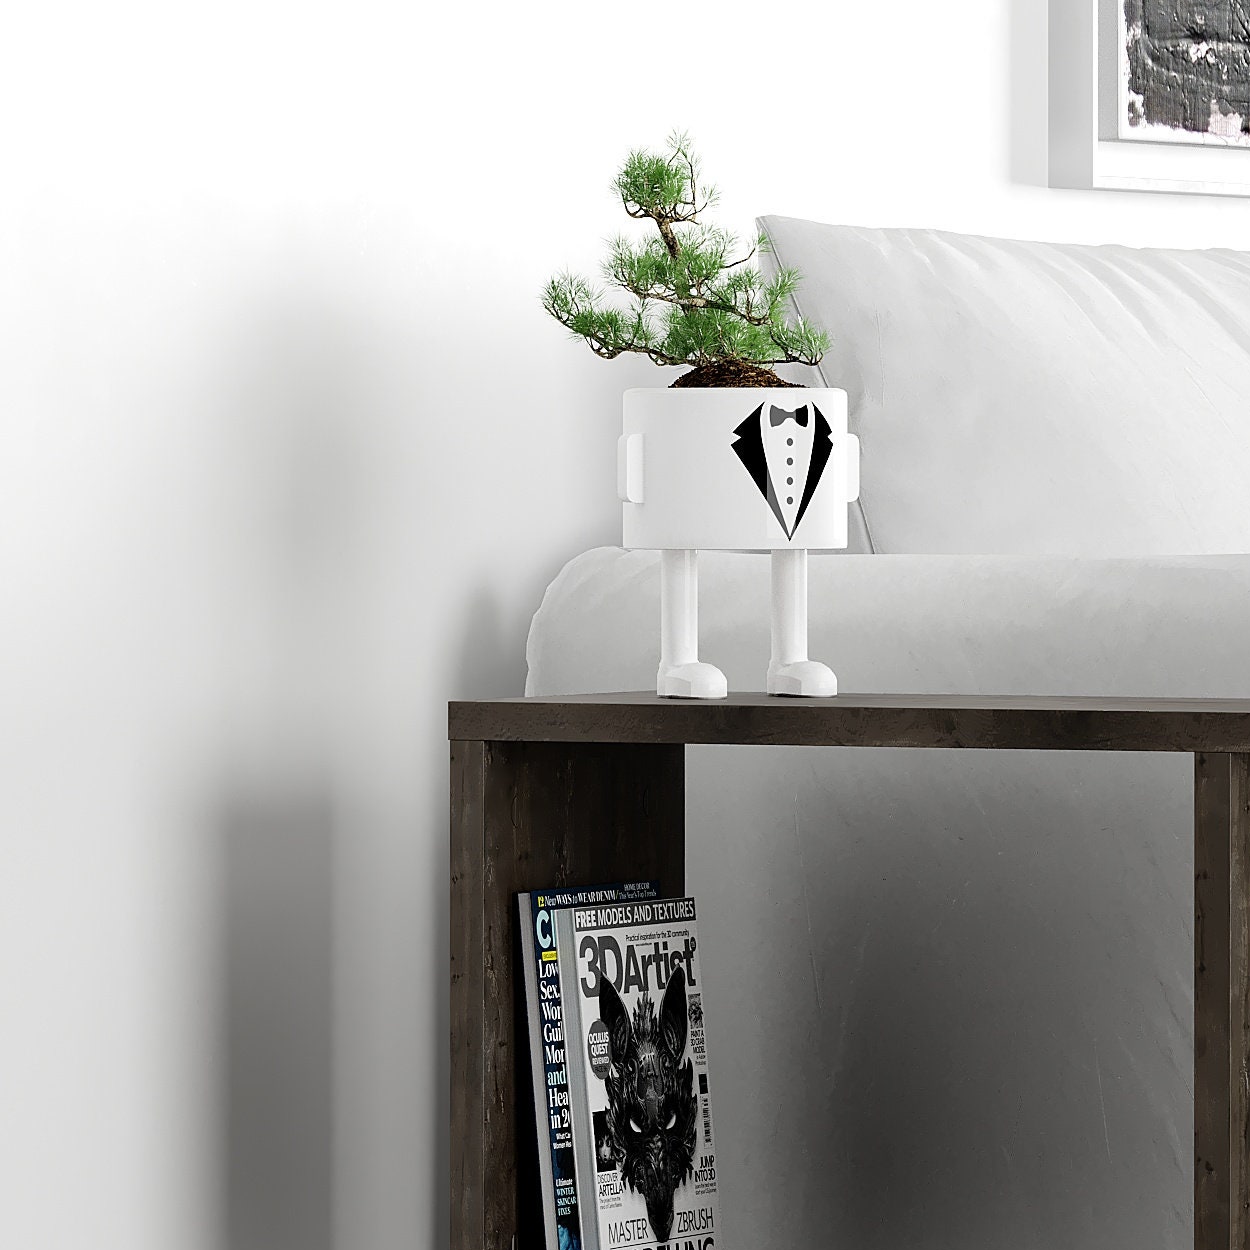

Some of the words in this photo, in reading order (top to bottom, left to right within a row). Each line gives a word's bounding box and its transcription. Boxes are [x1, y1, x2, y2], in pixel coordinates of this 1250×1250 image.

[545, 895, 556, 907] New
[577, 891, 596, 903] WEAR
[575, 910, 596, 928] FREE
[597, 907, 632, 925] MODELS
[633, 904, 651, 922] AND
[652, 901, 694, 921] TEXTURES
[541, 1002, 562, 1021] Wor
[588, 1032, 610, 1045] OCULUS
[591, 1043, 609, 1057] QUEST
[547, 1064, 567, 1086] and
[549, 1088, 569, 1108] Hea
[550, 1109, 561, 1129] in
[700, 1154, 715, 1169] JUMP
[597, 1172, 619, 1185] DISCOVER
[694, 1168, 708, 1183] INTO
[556, 1186, 575, 1197] WINTER
[598, 1181, 624, 1197] ARTELLA
[557, 1196, 577, 1207] SKINCAR
[608, 1217, 649, 1245] MASTER
[676, 1206, 714, 1234] ZBRUSH
